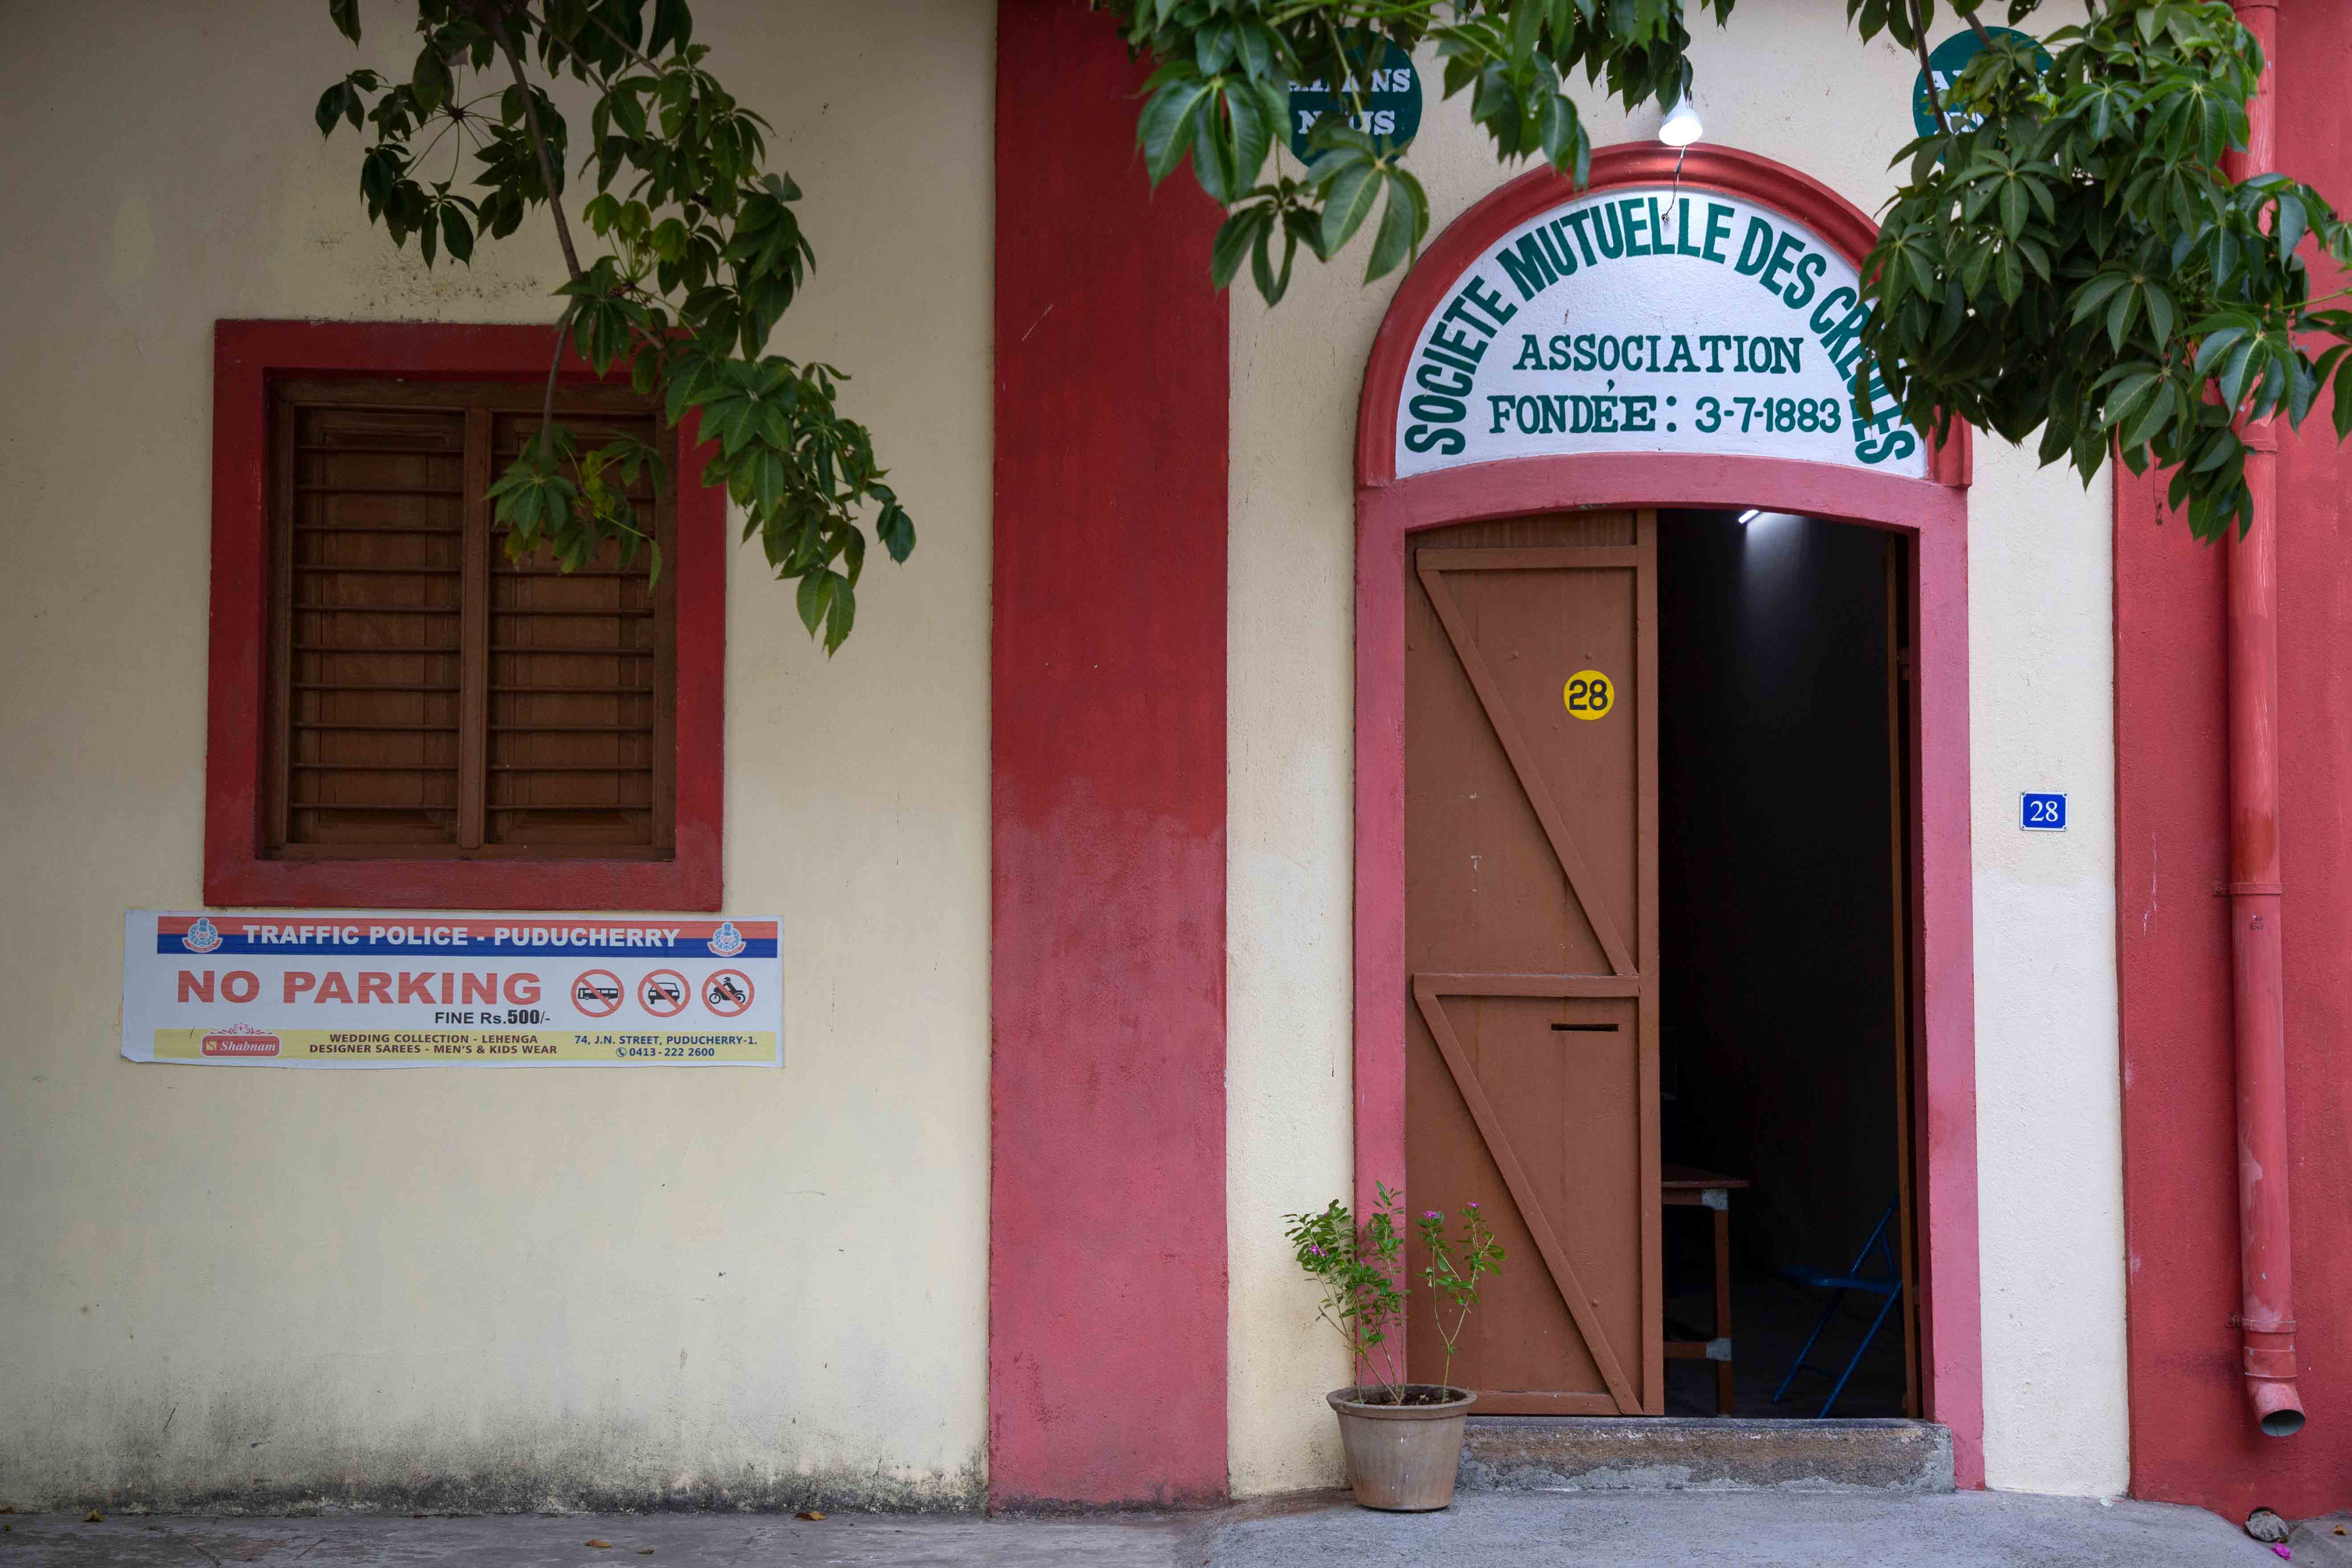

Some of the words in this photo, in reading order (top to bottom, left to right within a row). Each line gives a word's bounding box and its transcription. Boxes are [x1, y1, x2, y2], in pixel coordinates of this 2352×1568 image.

[1298, 110, 1395, 135] NUS
[1405, 275, 1518, 455] SOCIETE
[1496, 197, 1735, 302] MUTUELLE
[1734, 216, 1827, 310] DES
[1512, 333, 1804, 374] ASSOCIATION
[1695, 396, 1841, 434] 3-7-1883
[1569, 679, 1608, 710] 28
[2030, 800, 2058, 822] 28
[243, 925, 359, 945] TRAFFIC
[370, 926, 468, 946] POLICE
[495, 927, 680, 947] PUDUCHERRY
[177, 971, 260, 1003] NO
[283, 972, 541, 1005] PARKING
[435, 1012, 474, 1024] FINE
[221, 1040, 276, 1052] Shabnam
[310, 1044, 371, 1053] DESIGNER
[376, 1045, 421, 1053] SAREES
[476, 1045, 485, 1054] &
[490, 1045, 517, 1054] KIDS
[522, 1045, 556, 1054] WEAR
[329, 1034, 389, 1043] WEDDING
[395, 1034, 469, 1043] COLLECTION
[482, 1035, 538, 1043] LEHENGA
[574, 1035, 590, 1045] 74,
[594, 1036, 615, 1045] J.N.
[619, 1036, 662, 1045] STREET,
[667, 1036, 757, 1045] PUDUCHERRY-1.
[688, 1048, 715, 1057] 2600
